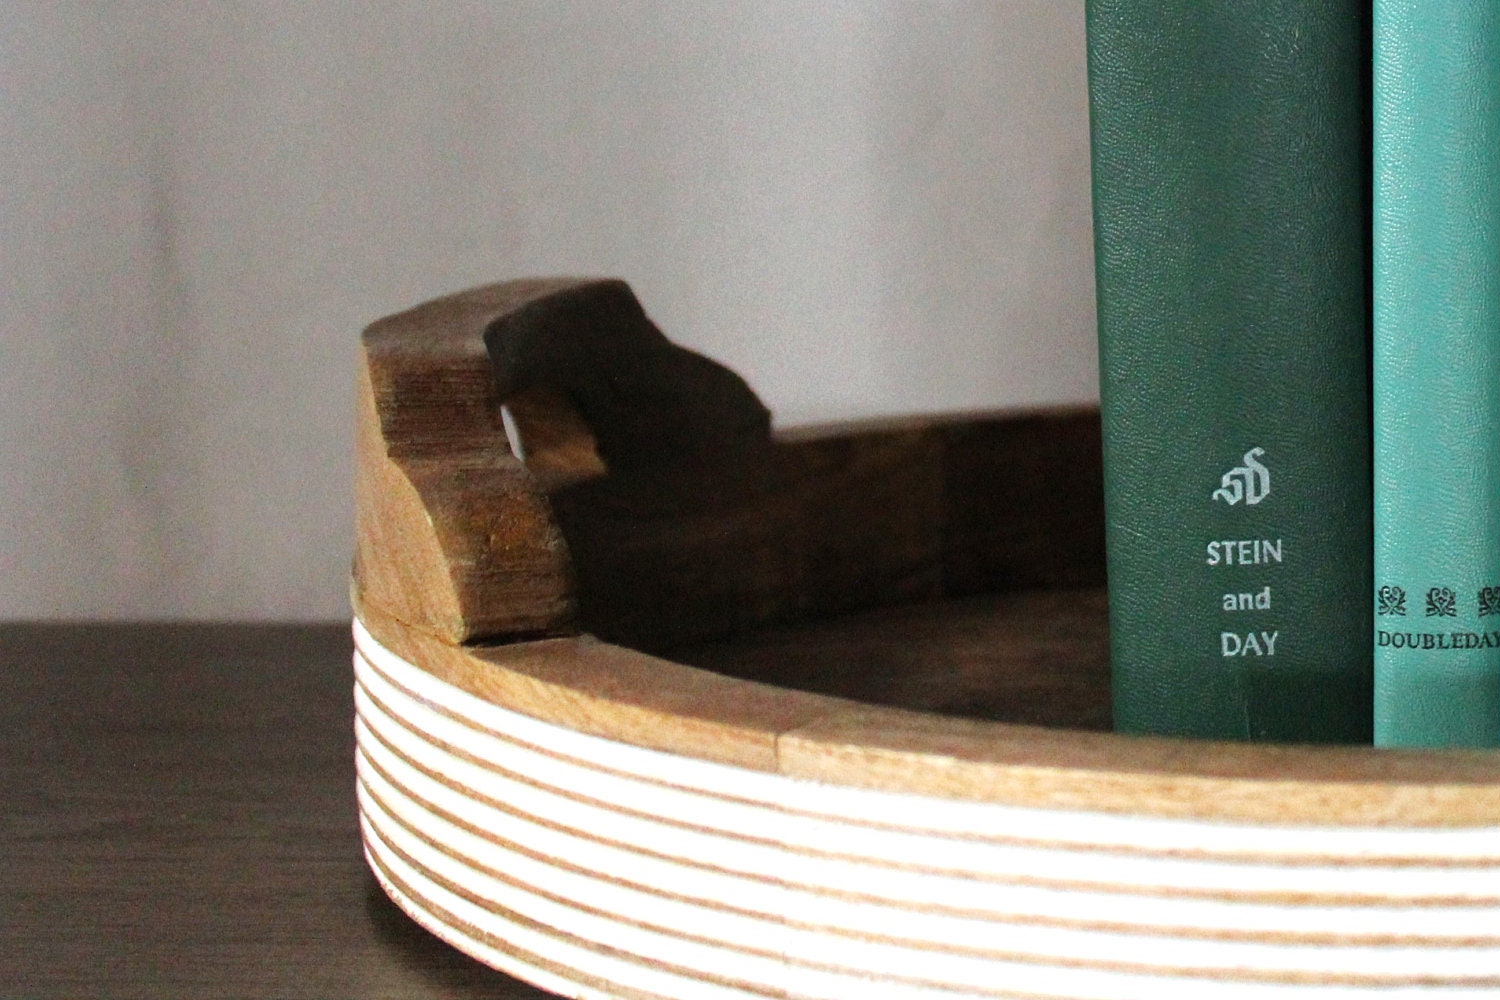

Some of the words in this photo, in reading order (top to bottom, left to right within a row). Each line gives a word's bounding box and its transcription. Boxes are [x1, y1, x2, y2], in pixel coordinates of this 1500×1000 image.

[1206, 539, 1283, 565] STEIN
[1222, 587, 1271, 611] and
[1220, 630, 1279, 656] DAY
